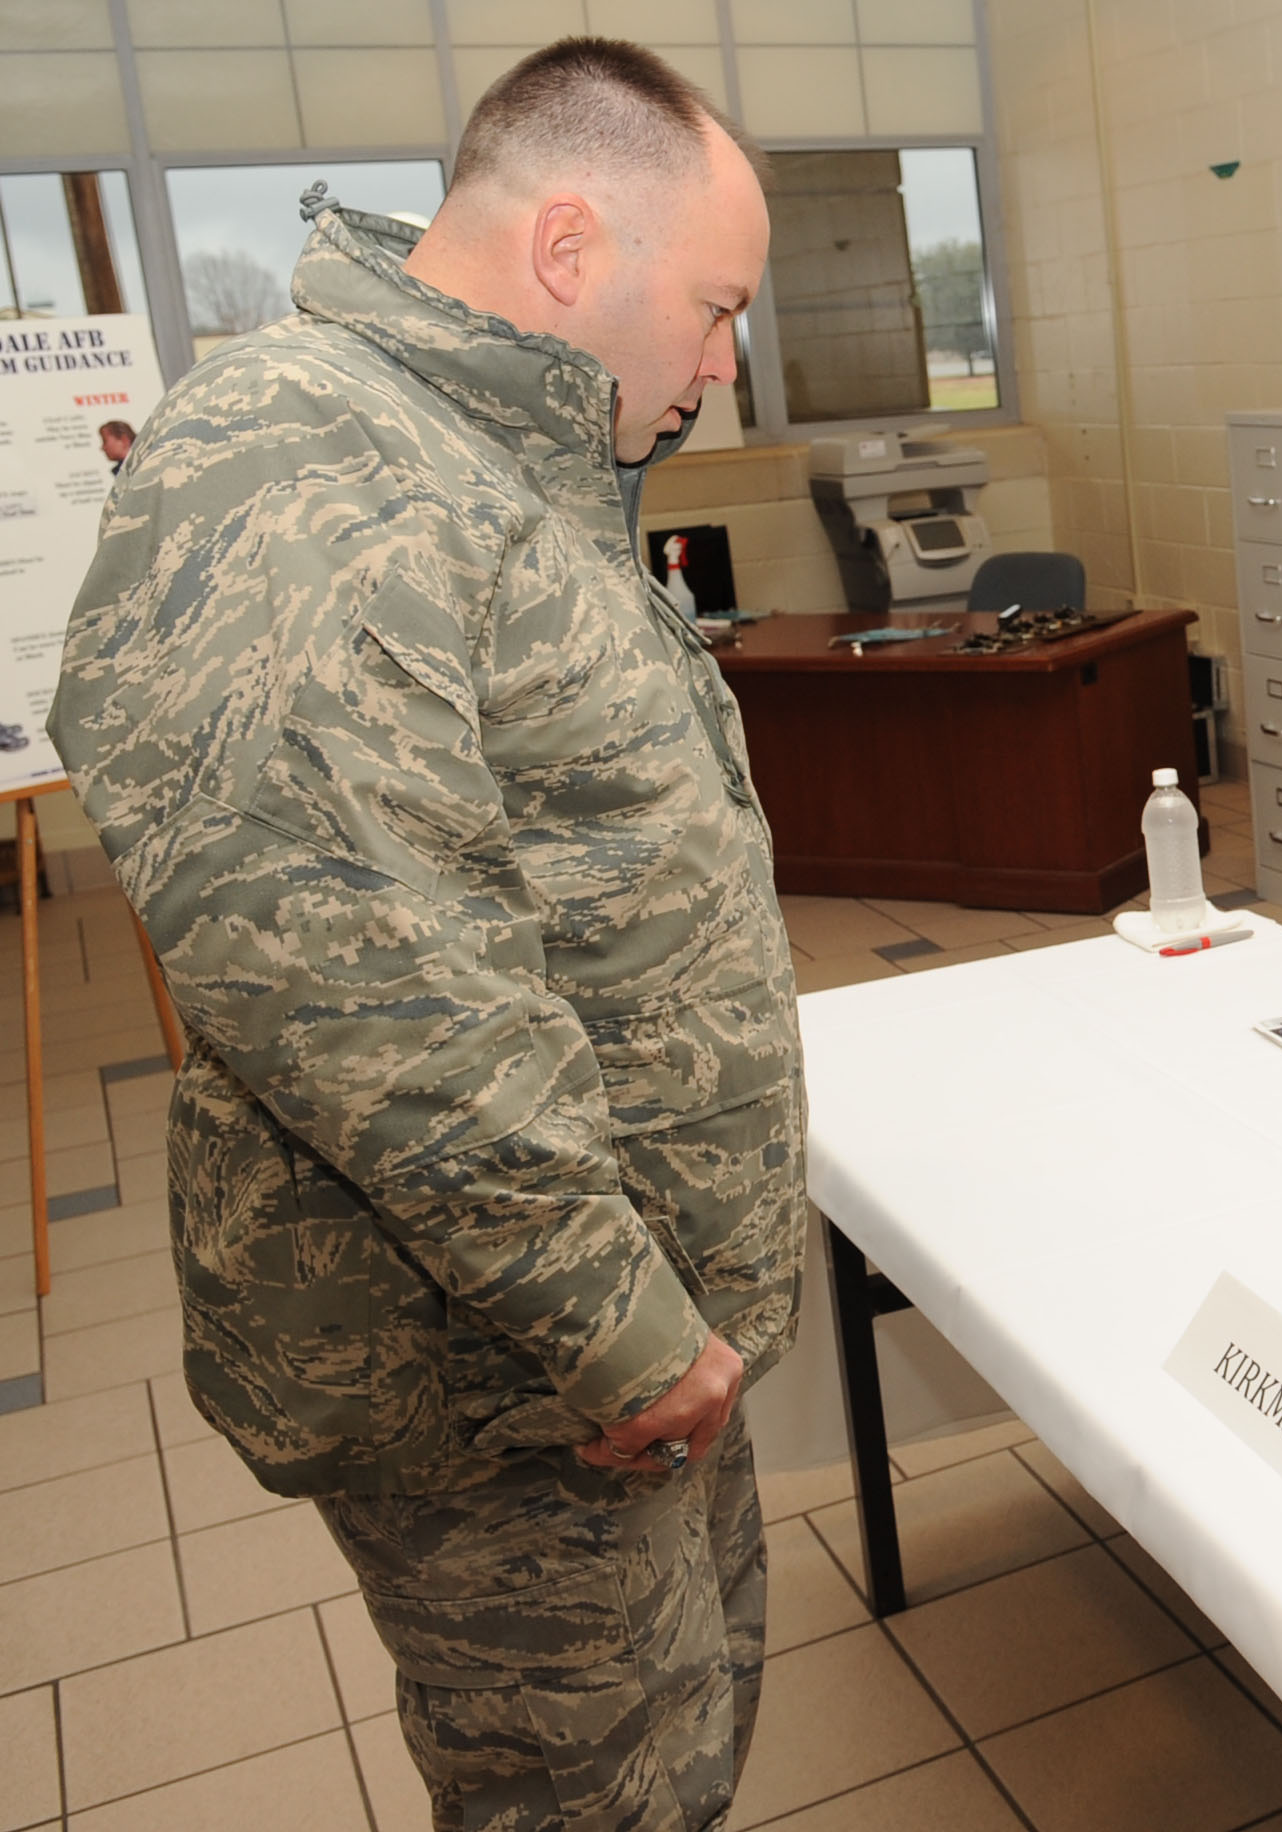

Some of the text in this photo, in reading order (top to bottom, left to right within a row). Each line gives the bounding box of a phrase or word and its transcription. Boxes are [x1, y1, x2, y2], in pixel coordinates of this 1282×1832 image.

[0, 328, 104, 354] ALE AFB
[24, 350, 132, 373] GUIDANCE
[73, 392, 130, 406] WINTER
